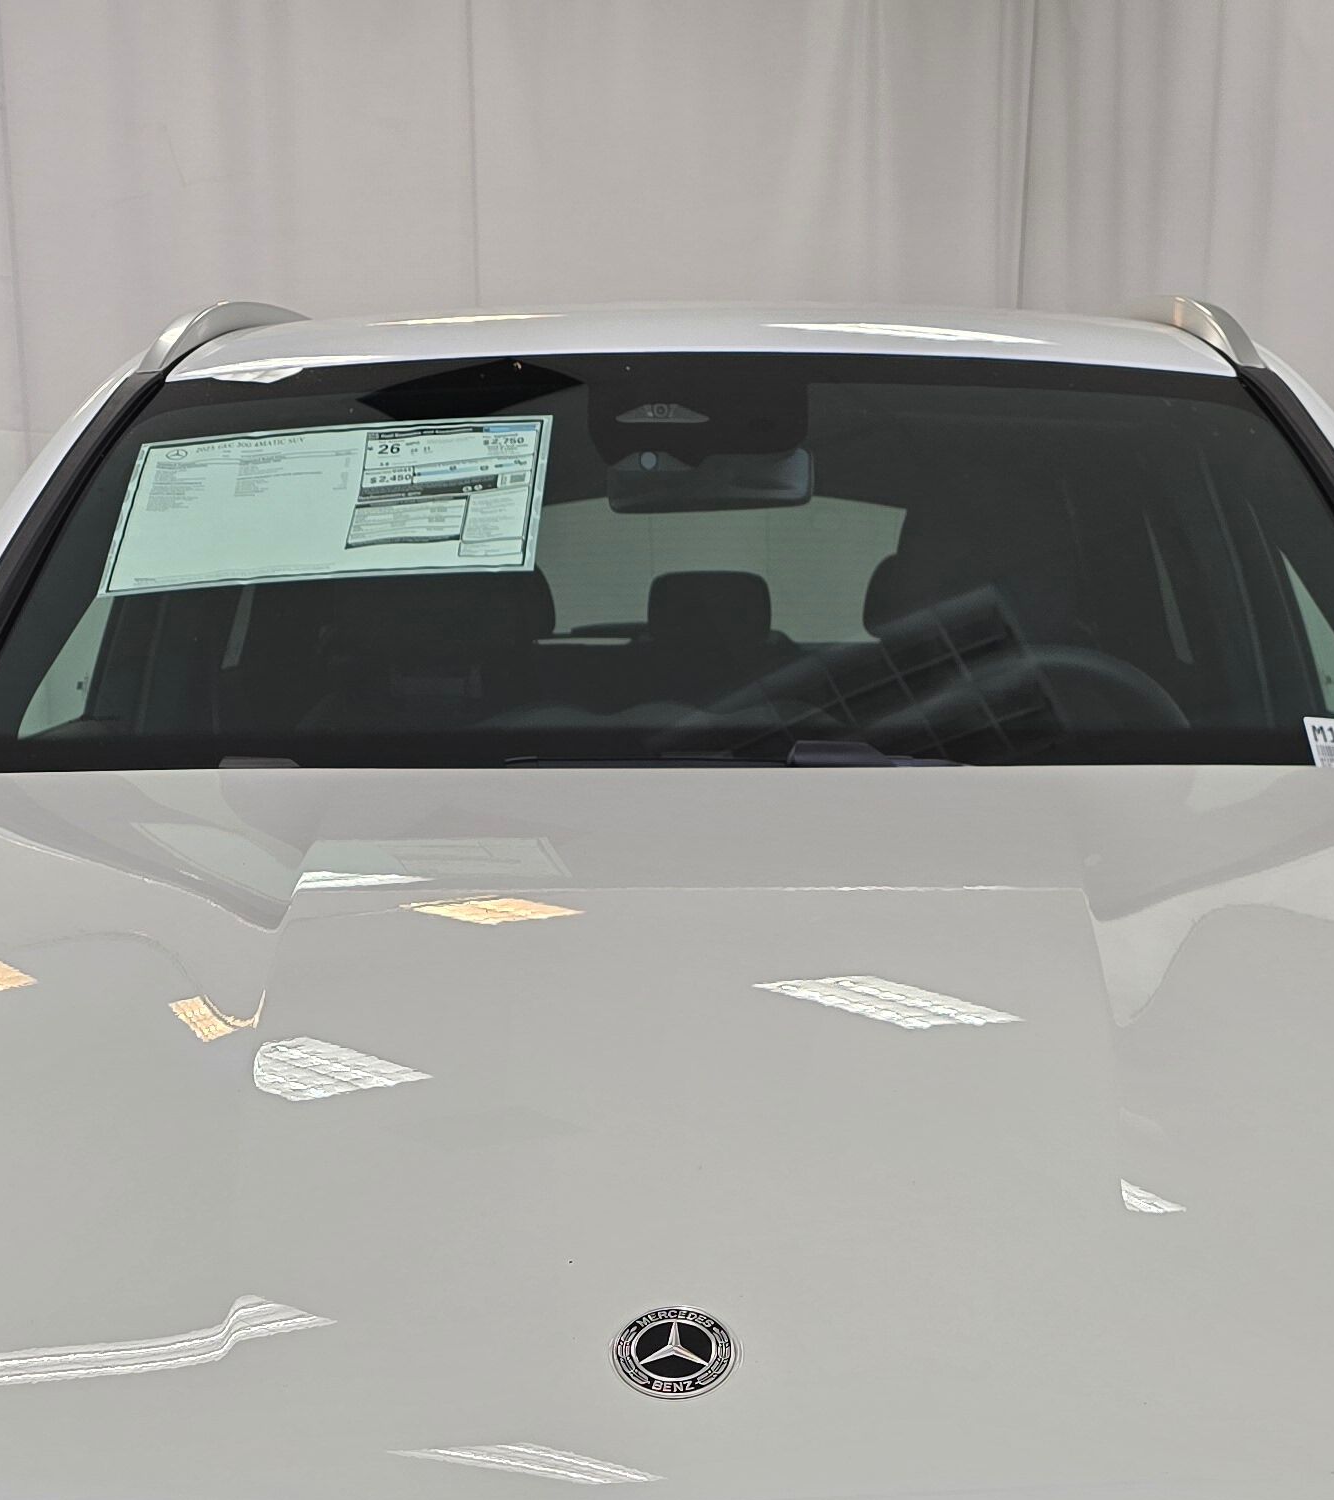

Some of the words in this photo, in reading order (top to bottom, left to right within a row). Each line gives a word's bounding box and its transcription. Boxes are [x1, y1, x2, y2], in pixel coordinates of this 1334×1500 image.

[378, 443, 401, 455] 26
[635, 1309, 715, 1329] MERCEDES
[651, 1380, 695, 1392] BENZ
